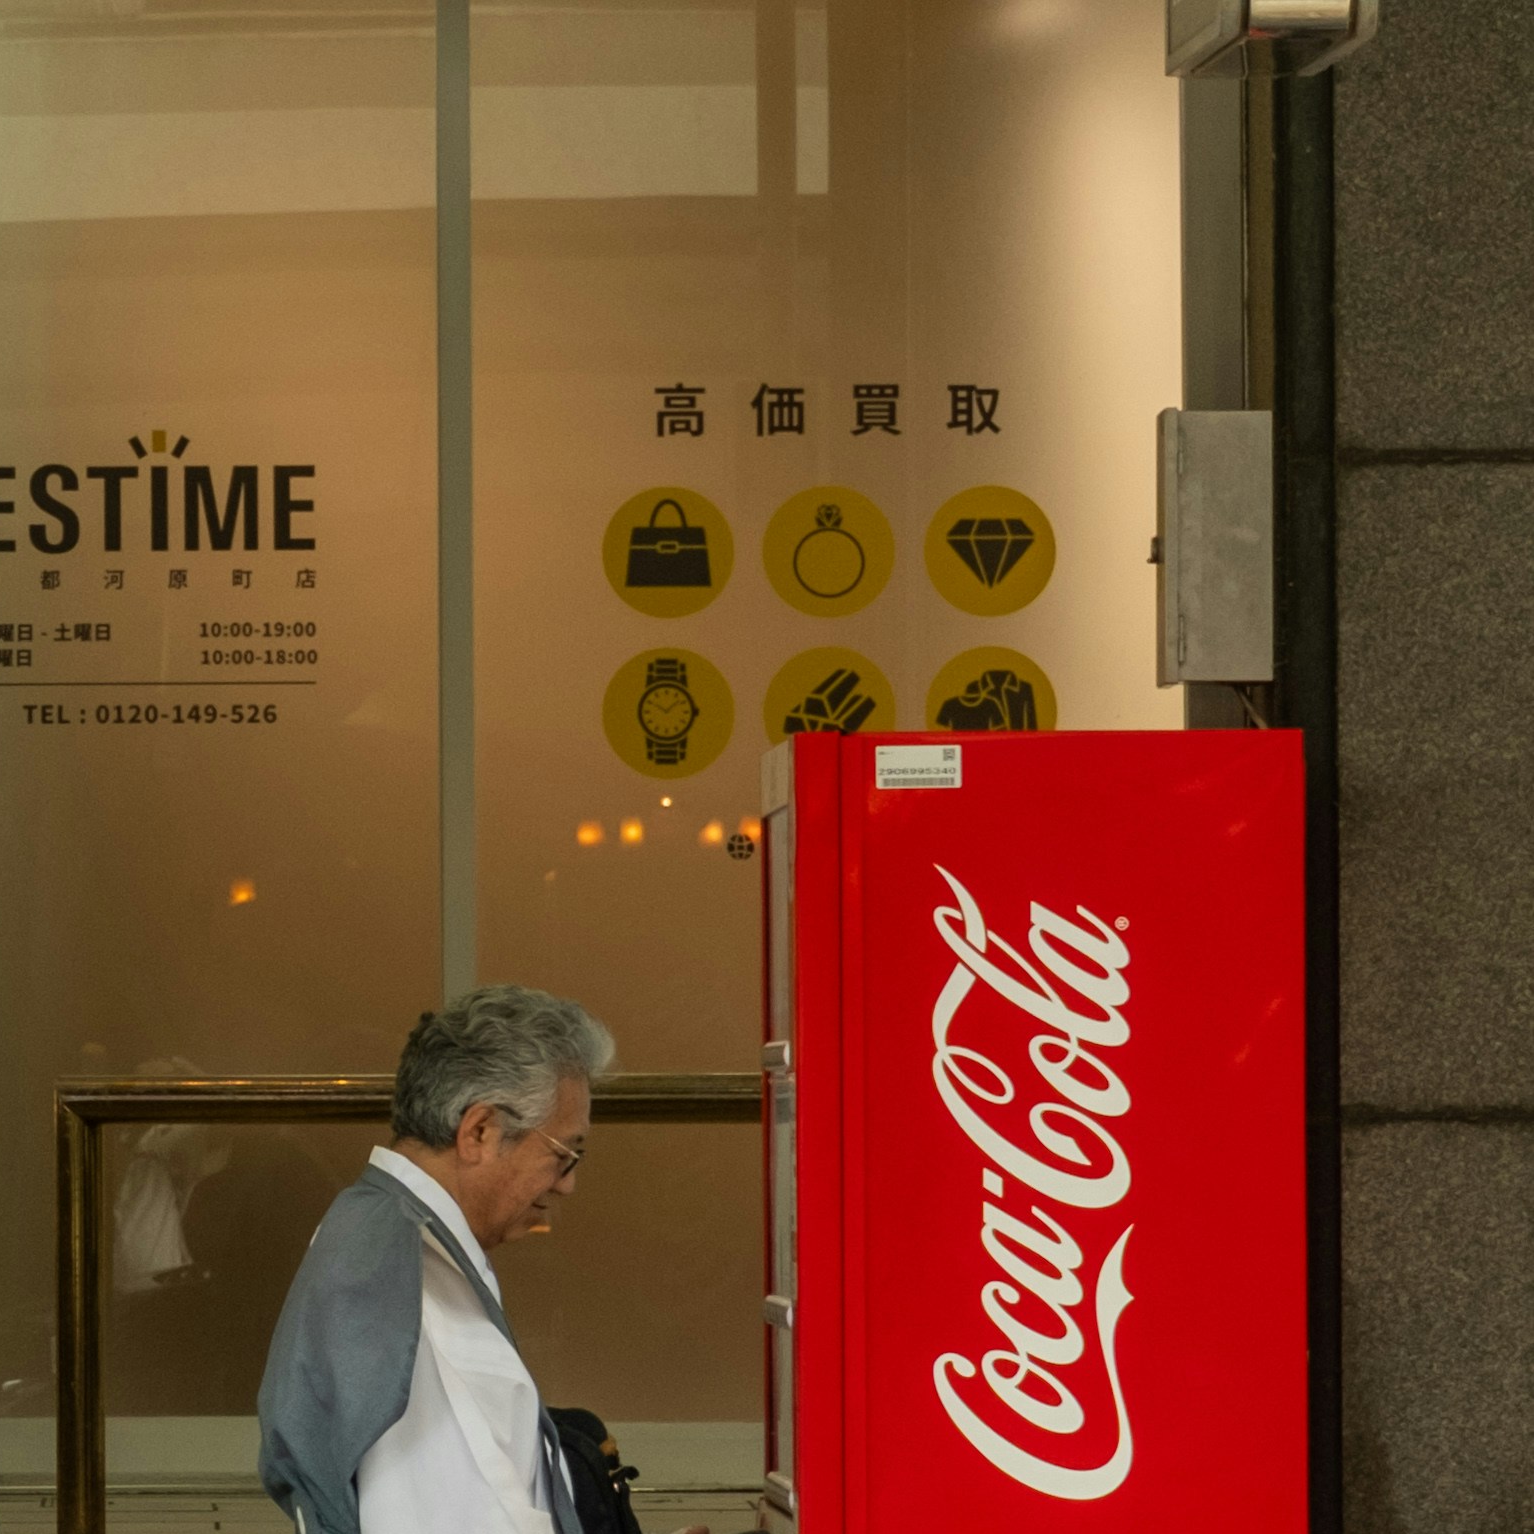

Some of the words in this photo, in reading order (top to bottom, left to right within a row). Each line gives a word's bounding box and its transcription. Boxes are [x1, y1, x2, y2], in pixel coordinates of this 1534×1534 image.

[653, 382, 1002, 438] 高価買取
[53, 623, 112, 642] 土曜日
[198, 621, 317, 639] 10:00-19:00
[200, 649, 318, 666] 10:00-18:00
[23, 704, 71, 724] TEL
[95, 703, 278, 725] 0120-149-526
[931, 863, 1134, 1500] Coca-Cola
